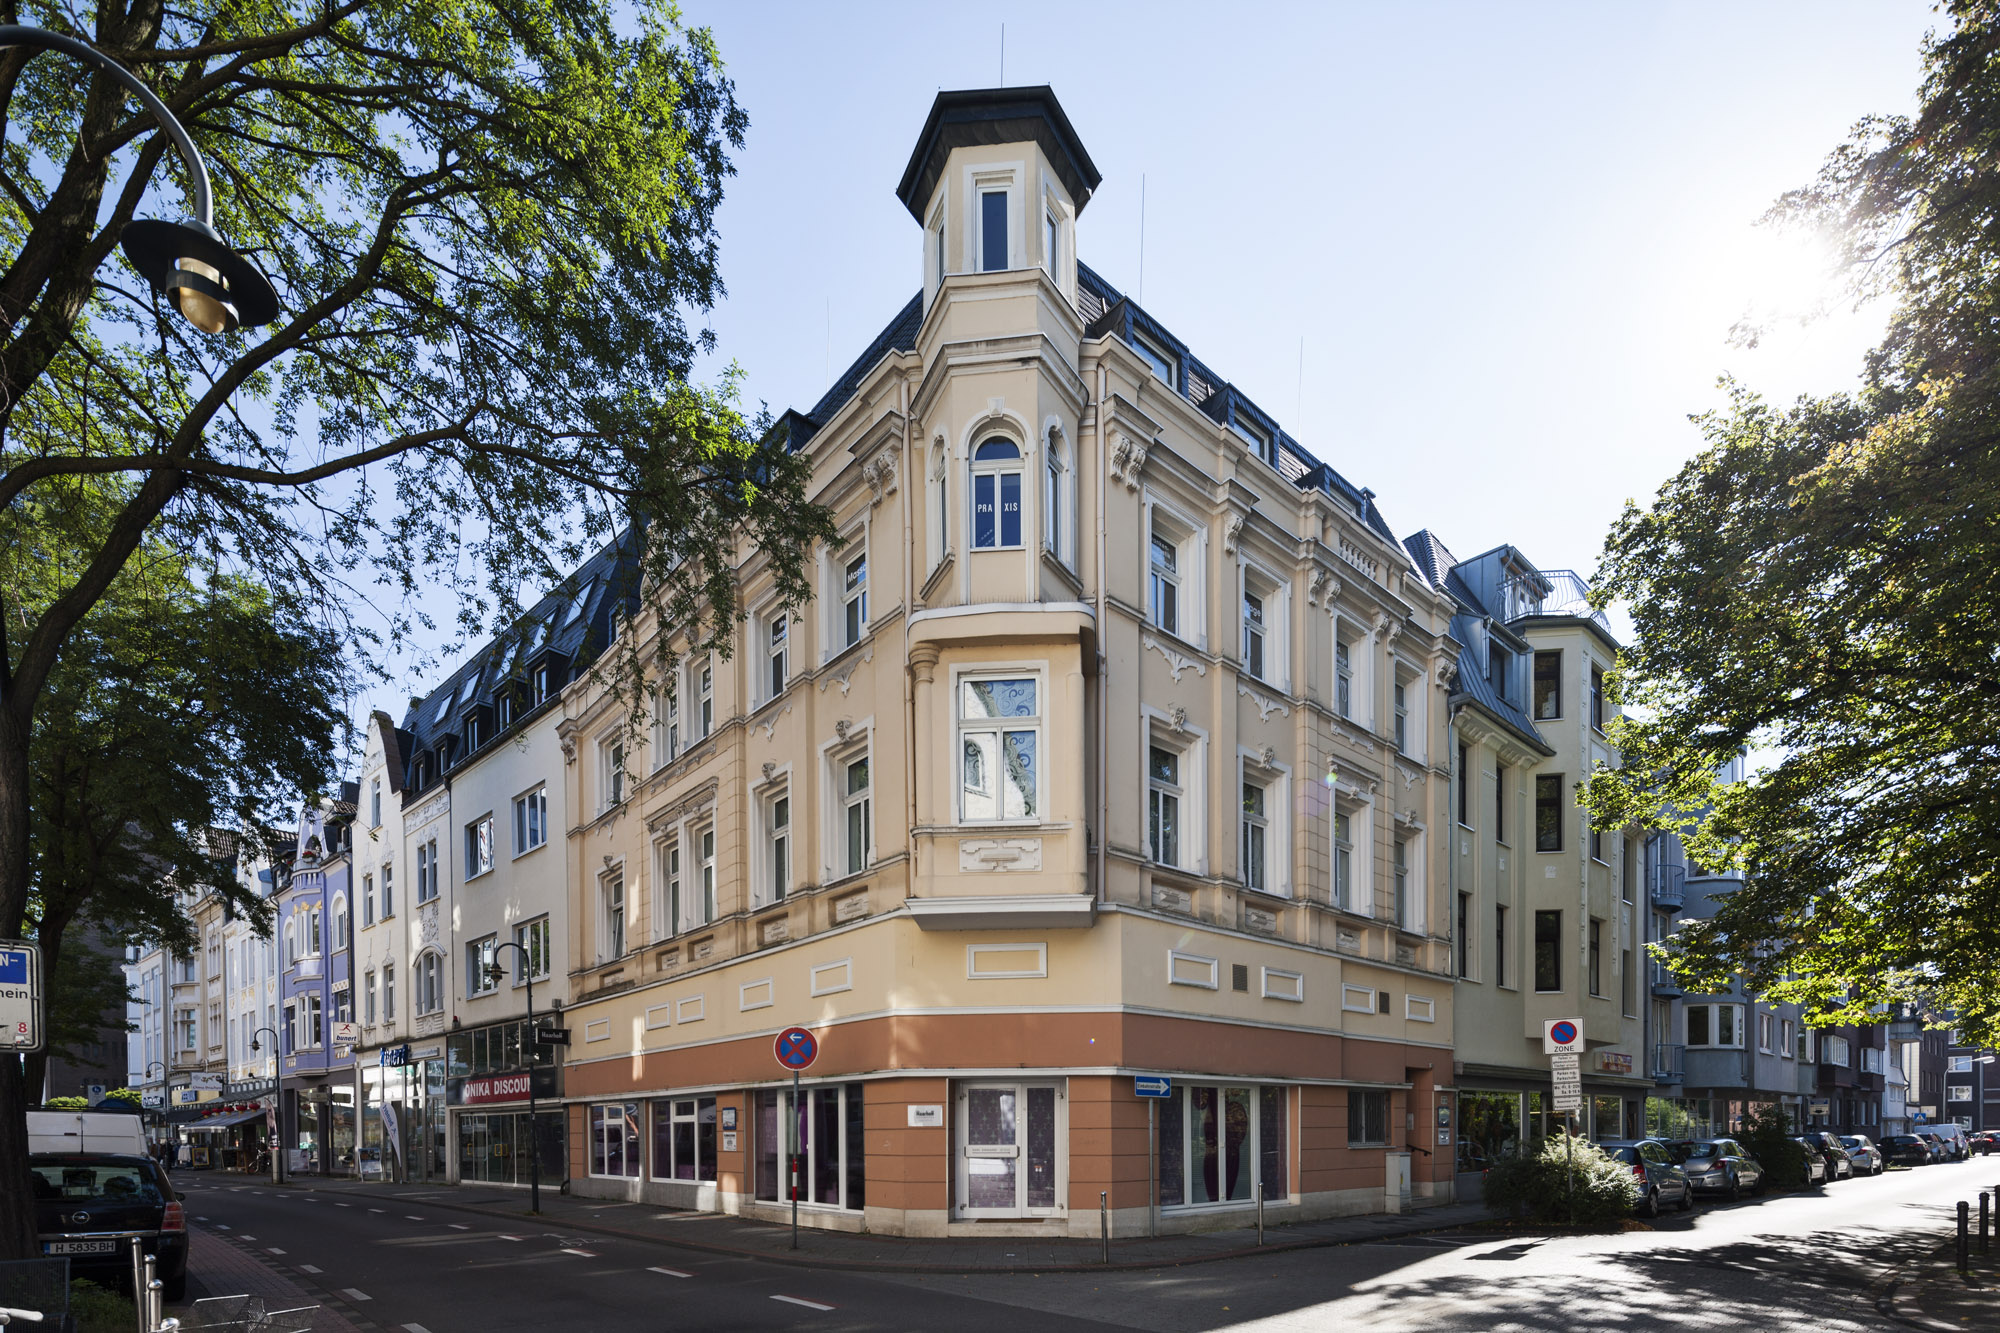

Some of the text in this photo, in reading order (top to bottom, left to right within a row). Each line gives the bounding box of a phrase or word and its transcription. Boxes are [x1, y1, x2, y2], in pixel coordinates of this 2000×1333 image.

[977, 502, 1018, 513] PRA XIS
[18, 1022, 28, 1033] 8
[1554, 1045, 1575, 1053] ZONE
[55, 1242, 114, 1253] H 5835 BH
